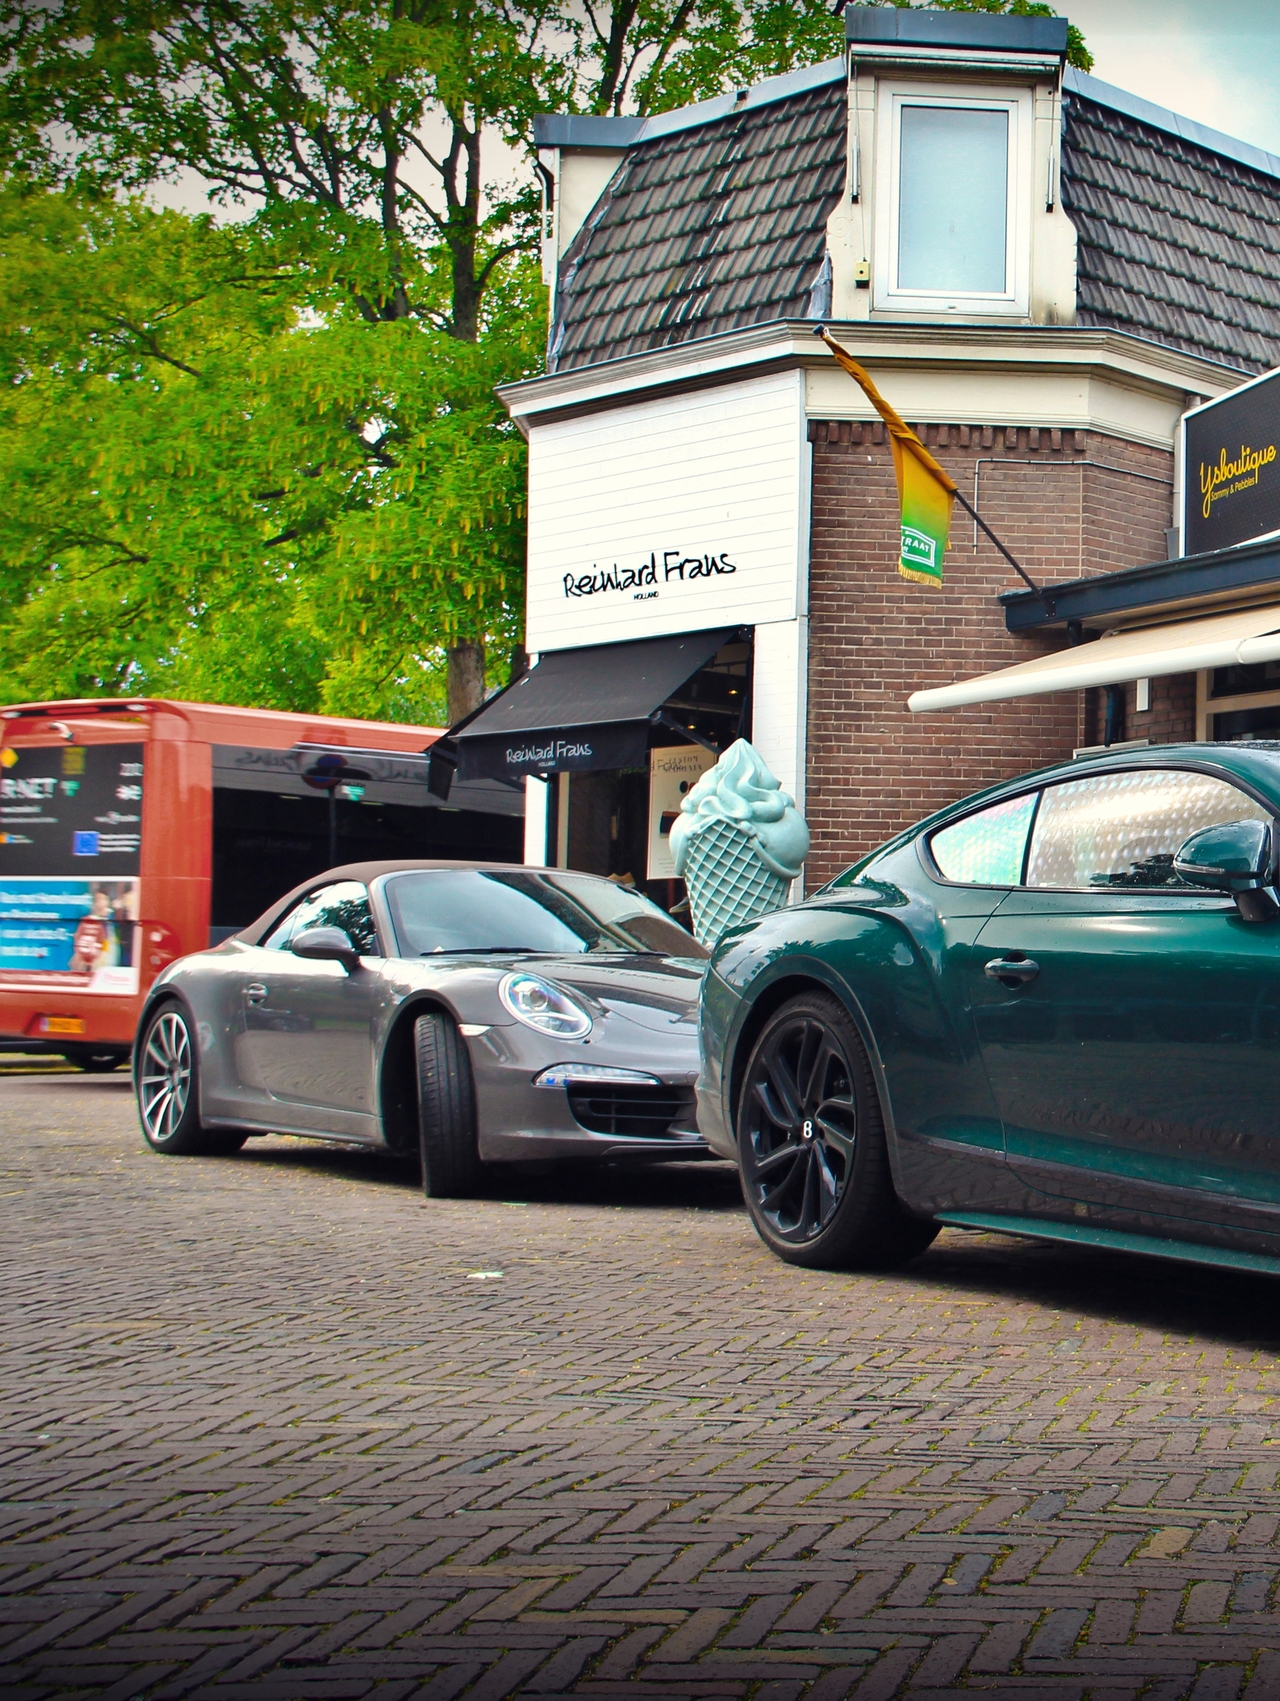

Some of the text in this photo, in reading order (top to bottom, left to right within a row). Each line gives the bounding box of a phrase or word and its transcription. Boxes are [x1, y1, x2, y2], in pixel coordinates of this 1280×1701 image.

[1200, 445, 1277, 518] Ysboutique
[1211, 477, 1255, 501] Sammy & Pebbles
[563, 551, 737, 598] Reinhard Frans
[633, 591, 659, 600] HOLLAND
[506, 741, 592, 763] Reinhard Frans
